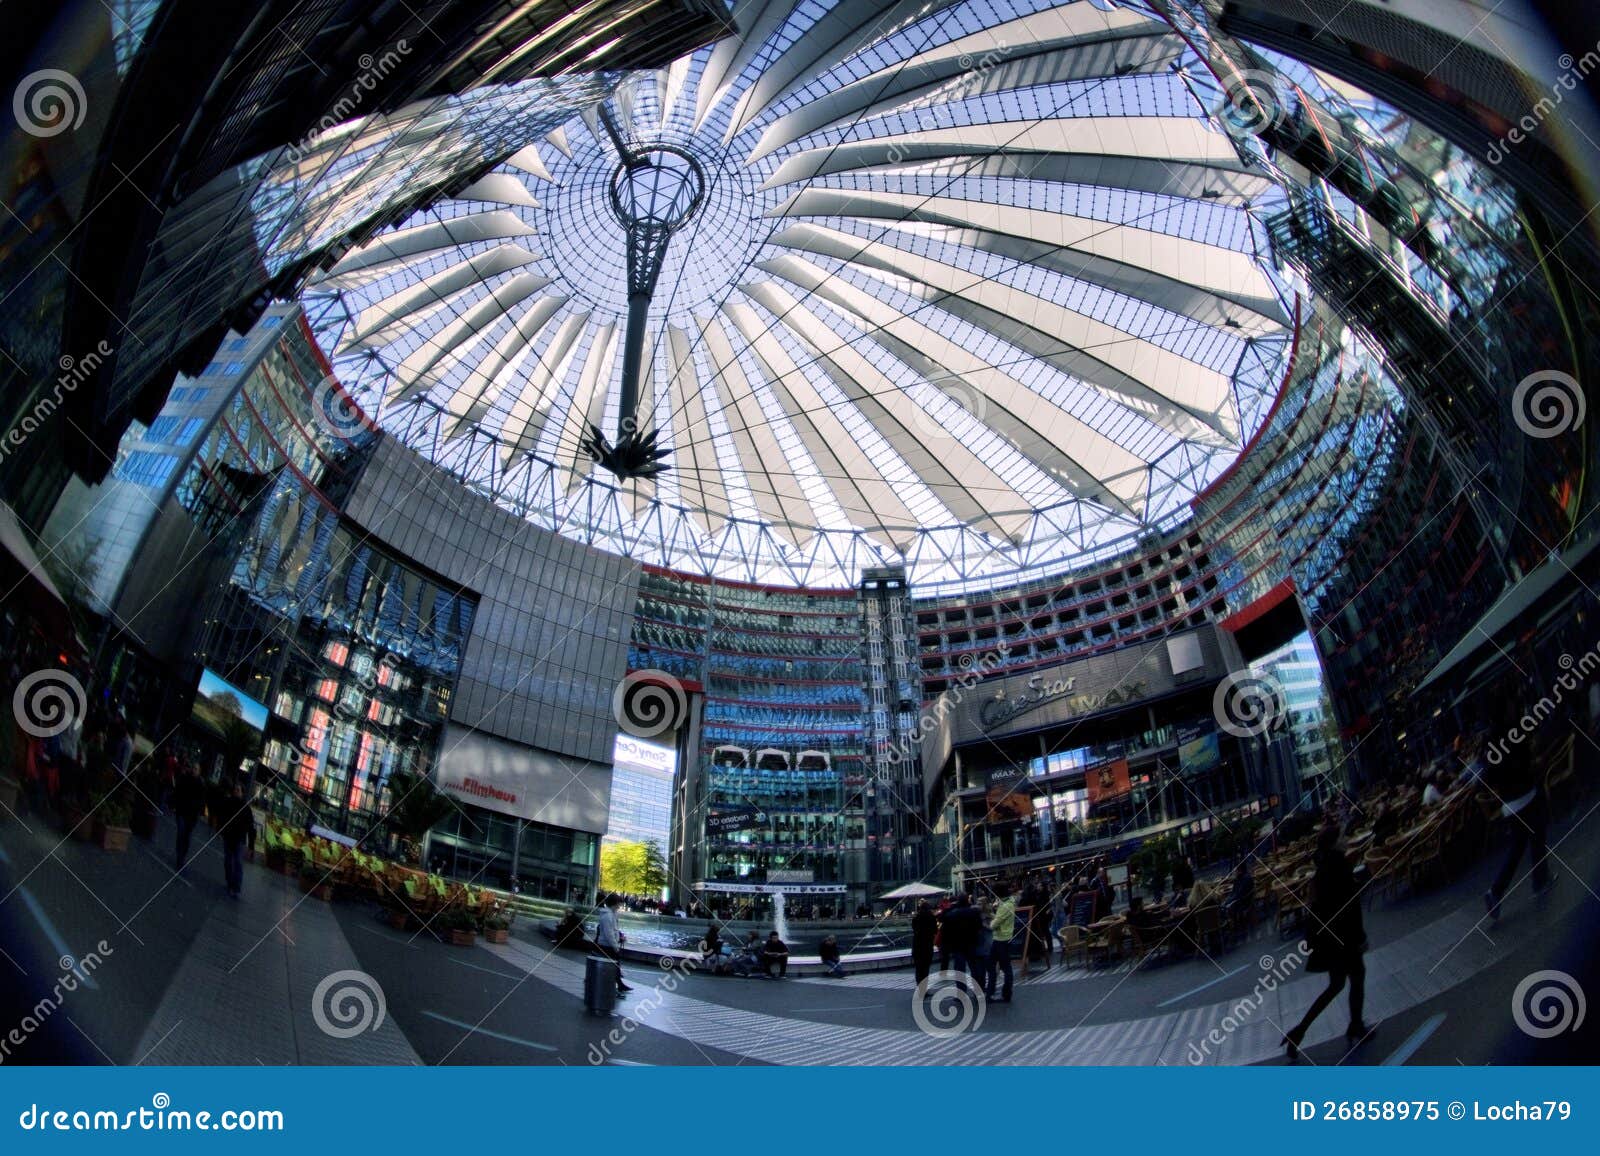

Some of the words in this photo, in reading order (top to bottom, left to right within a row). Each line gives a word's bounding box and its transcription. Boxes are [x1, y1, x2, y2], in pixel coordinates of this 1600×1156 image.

[1068, 680, 1146, 716] IMAX
[991, 768, 1016, 780] IMAX
[462, 777, 517, 804] Filmhaus
